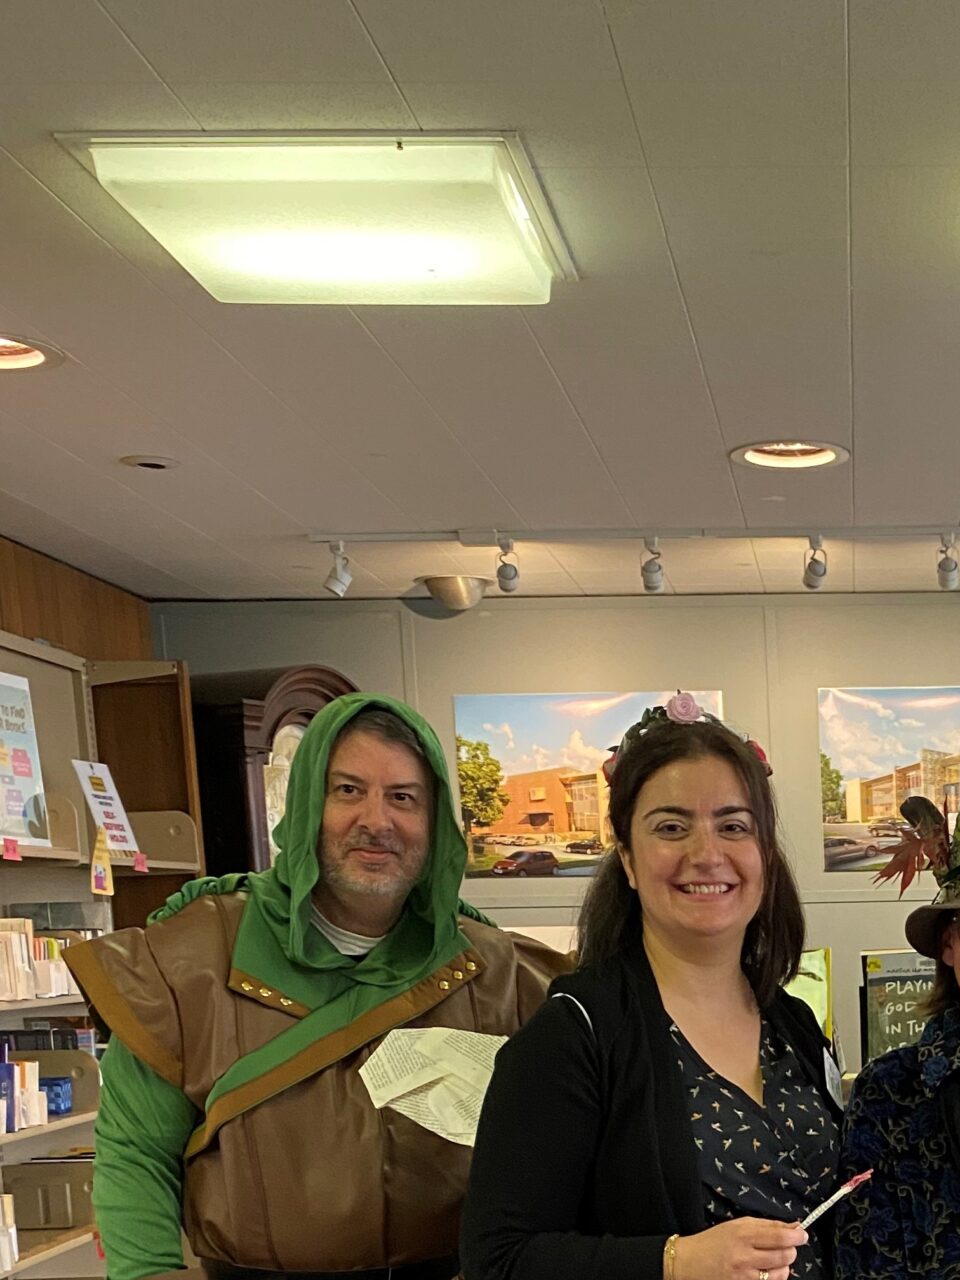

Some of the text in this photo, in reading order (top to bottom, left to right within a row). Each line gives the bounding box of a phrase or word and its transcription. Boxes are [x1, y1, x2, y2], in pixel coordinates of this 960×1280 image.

[885, 980, 934, 994] PLAYIN
[885, 1001, 917, 1015] GOD
[885, 1020, 925, 1035] IN TH
